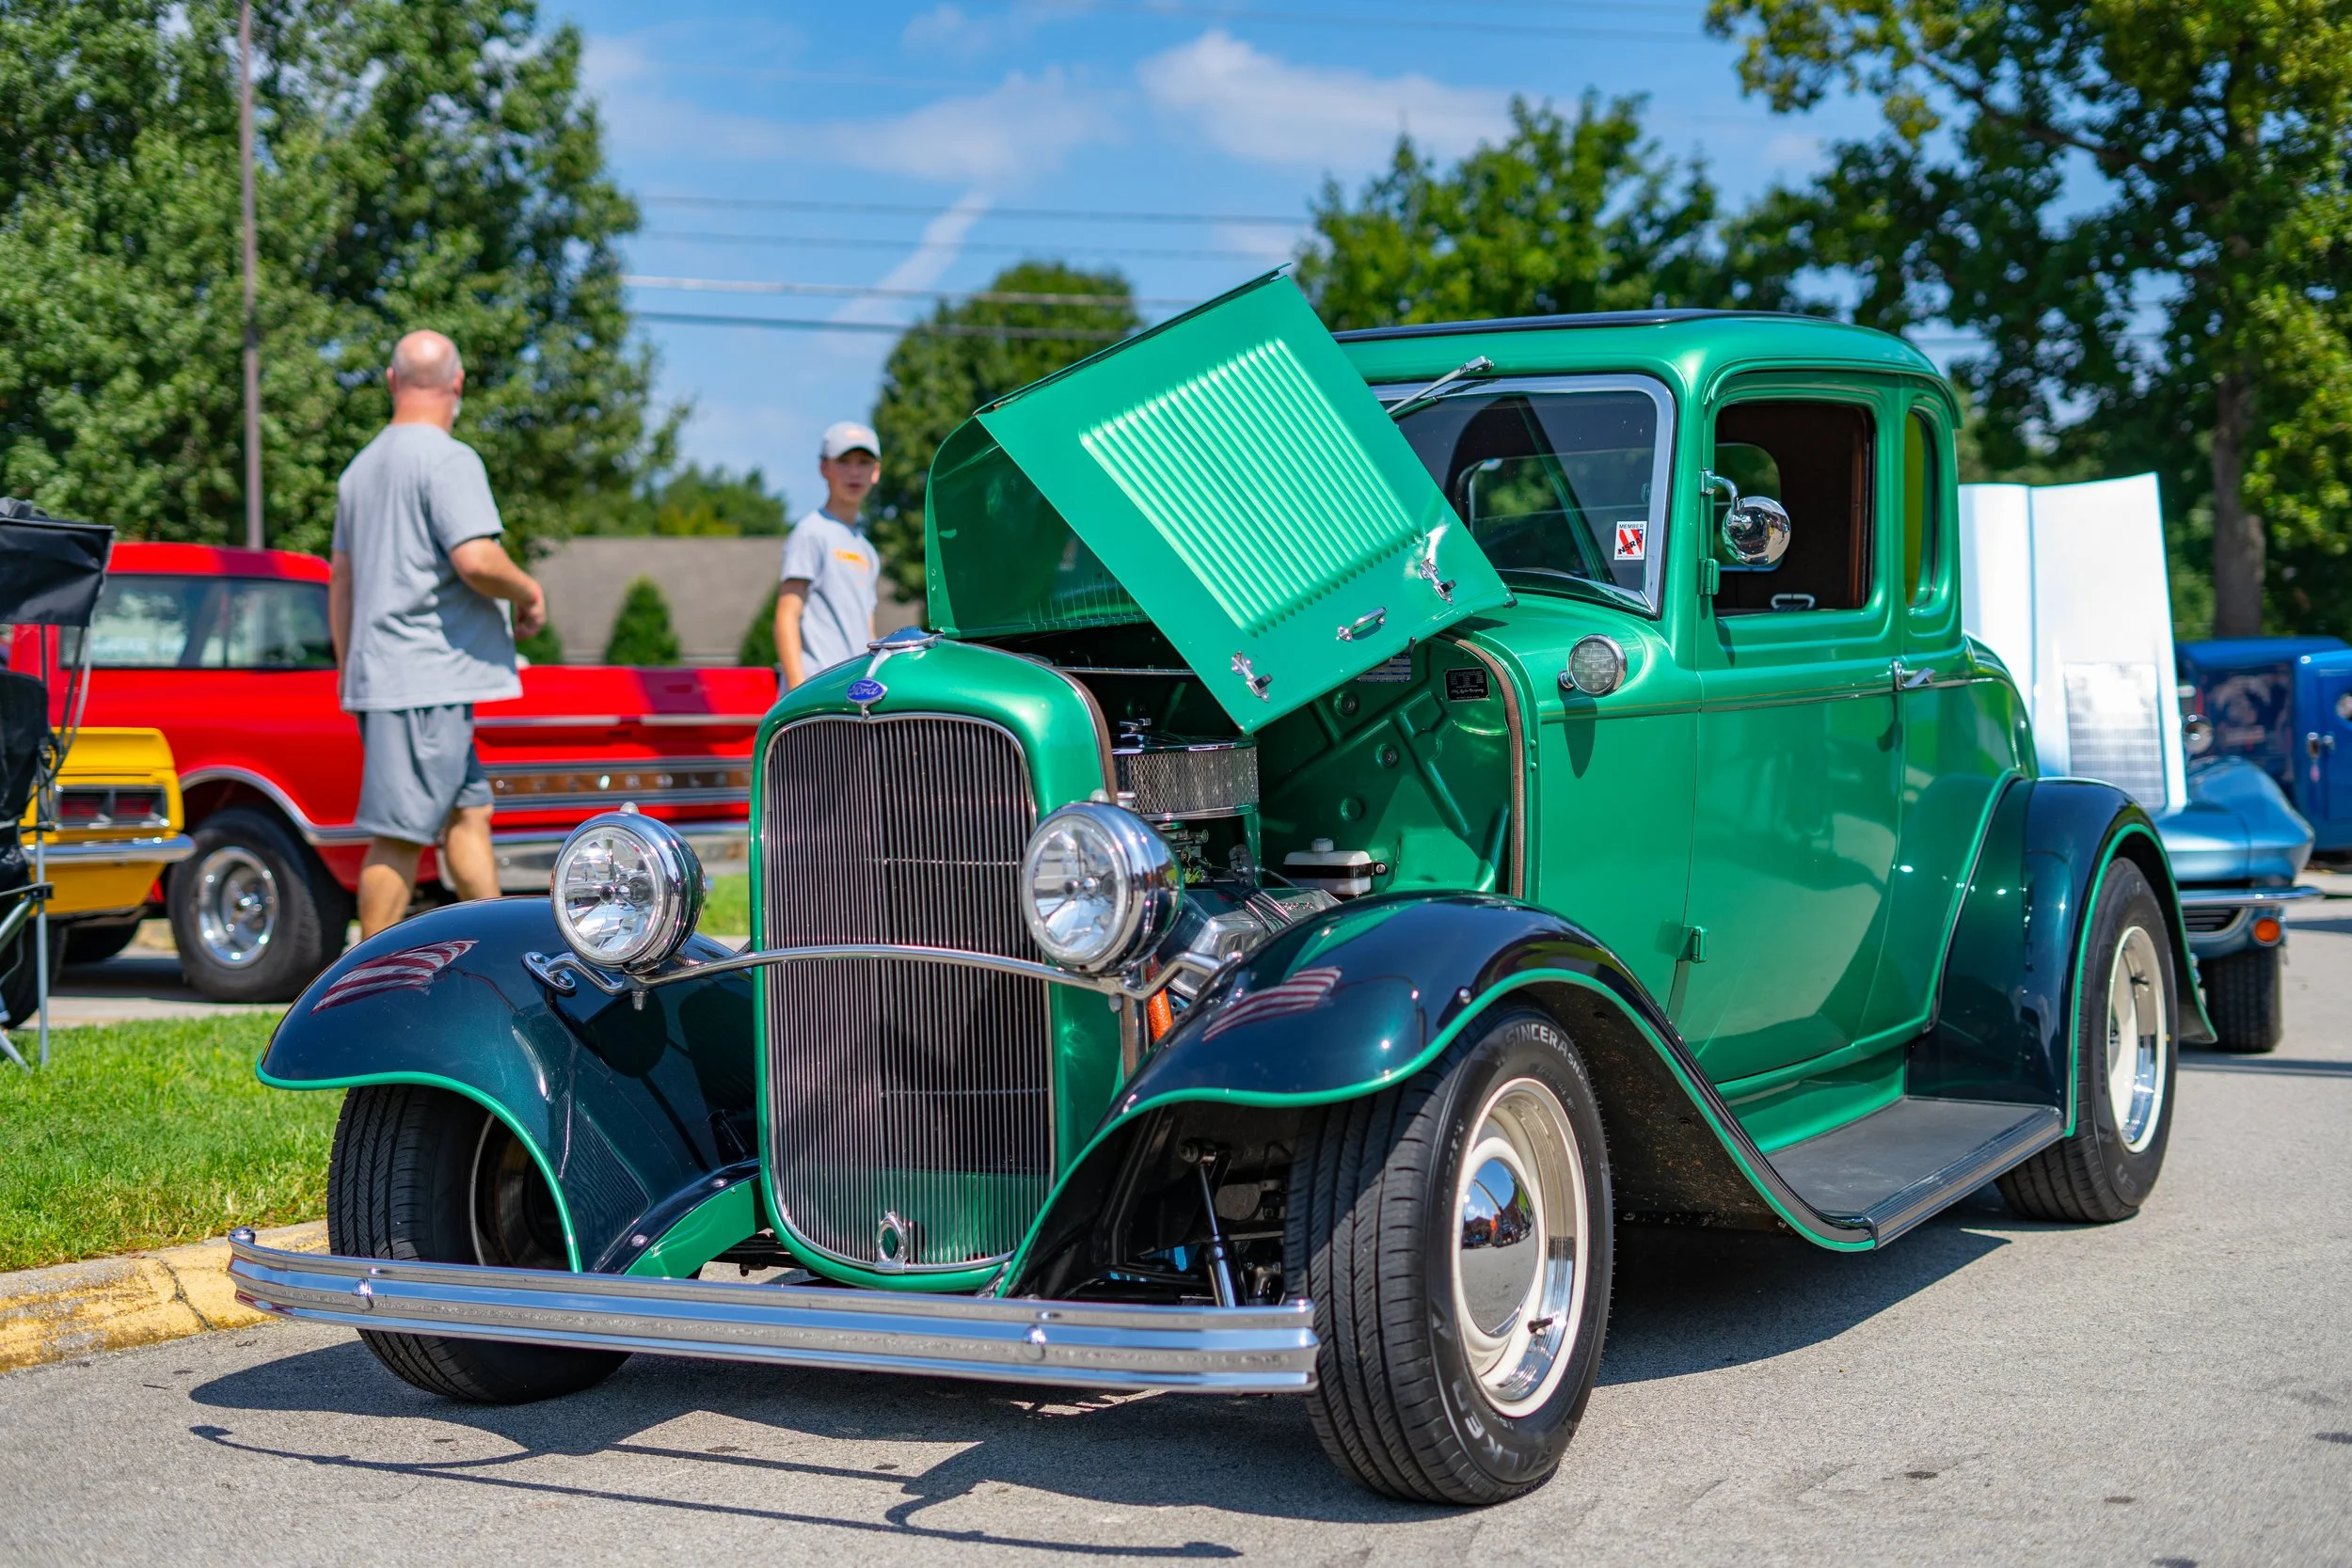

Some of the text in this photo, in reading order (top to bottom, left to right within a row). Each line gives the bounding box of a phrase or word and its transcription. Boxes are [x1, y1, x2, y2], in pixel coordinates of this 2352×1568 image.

[1617, 537, 1643, 555] NSRA
[849, 682, 880, 696] Ford
[1506, 1023, 1569, 1058] SINCERA
